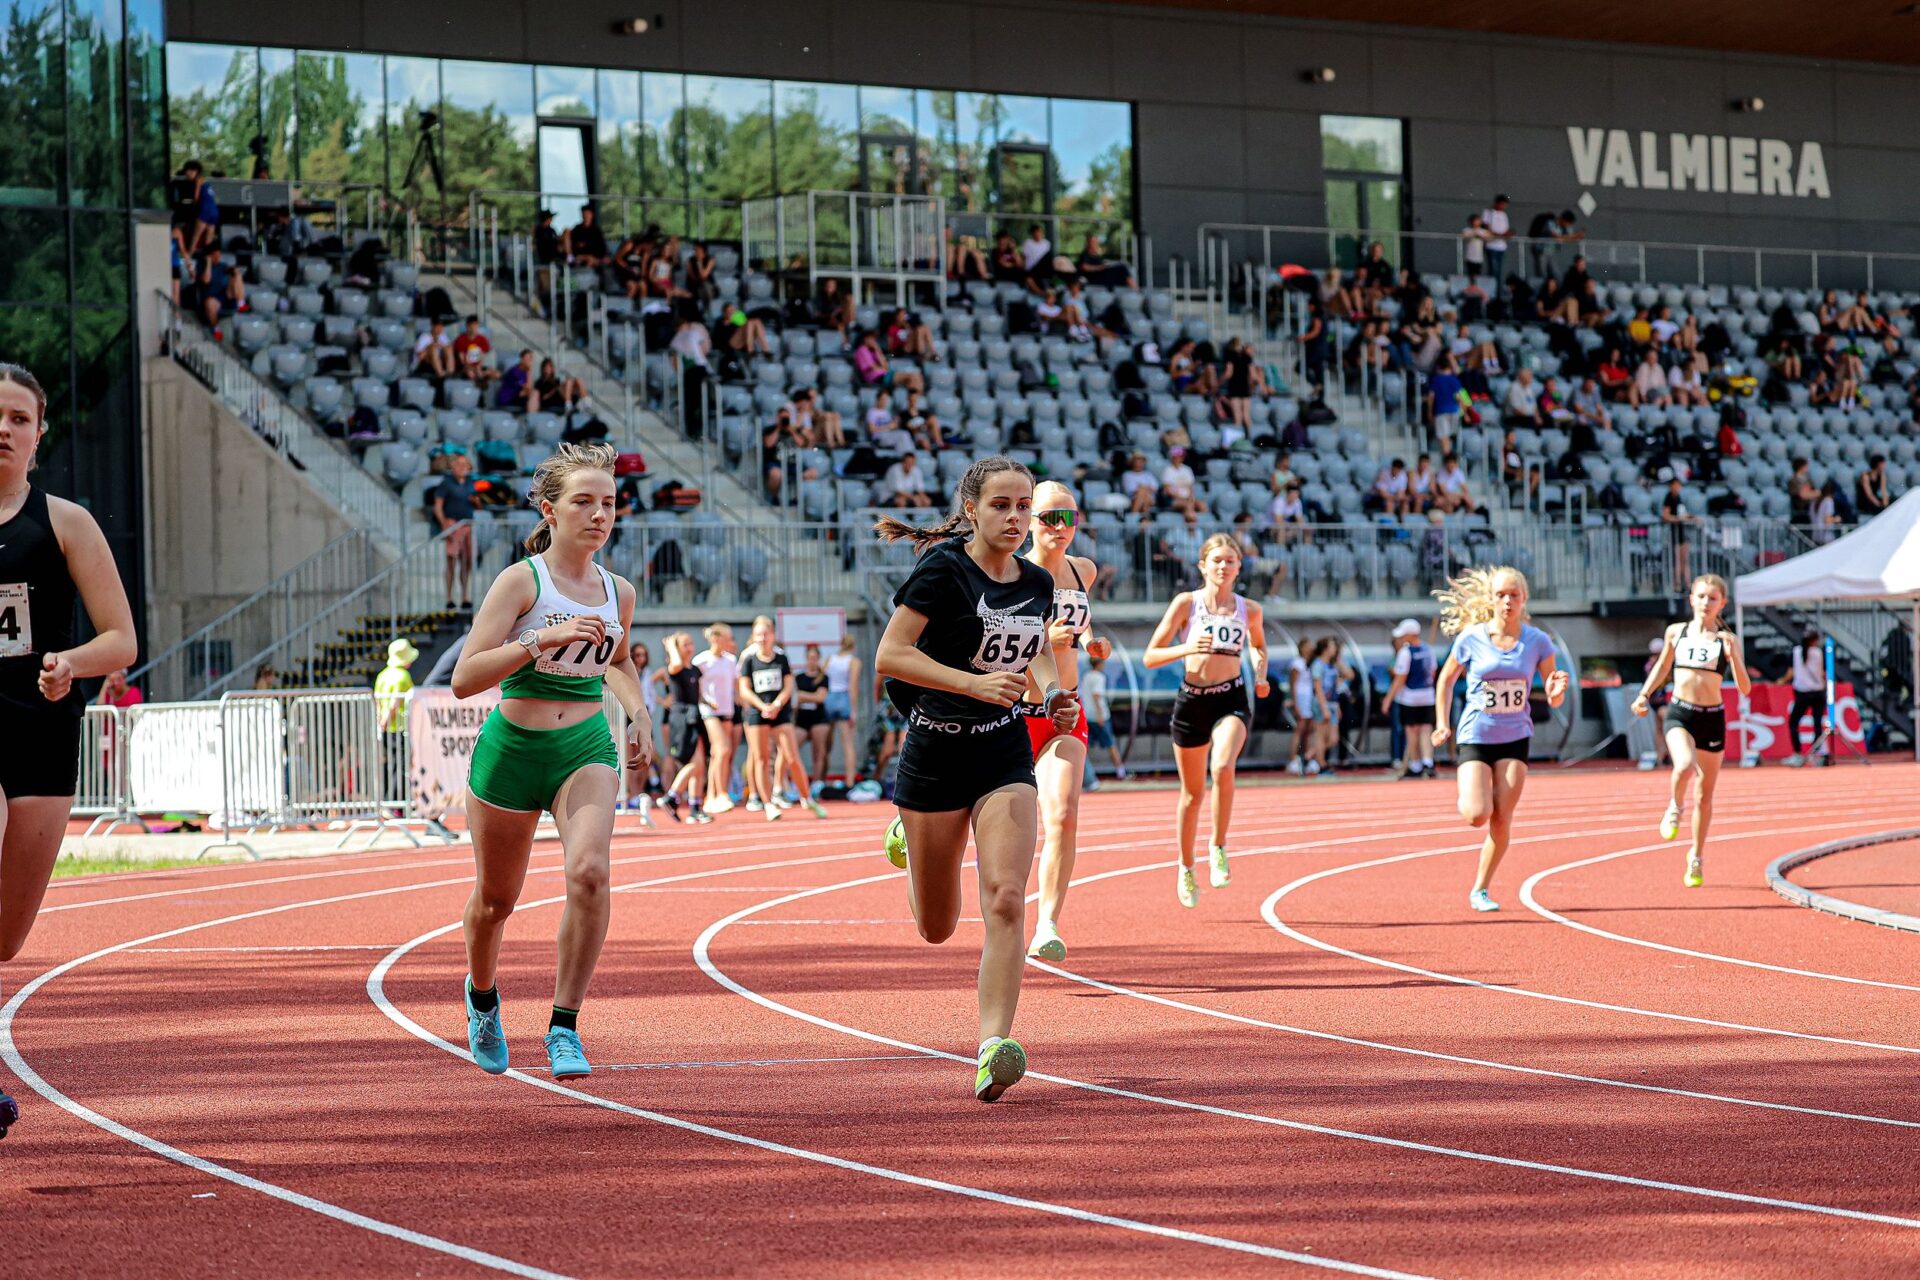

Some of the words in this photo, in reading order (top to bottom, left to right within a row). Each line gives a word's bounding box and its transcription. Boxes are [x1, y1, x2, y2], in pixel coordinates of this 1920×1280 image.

[1567, 126, 1831, 199] VALMIERA
[1053, 603, 1088, 626] 127
[982, 633, 1040, 664] 654
[1688, 648, 1708, 662] 13
[1486, 690, 1523, 708] 318
[916, 715, 962, 734] PRO
[971, 714, 1011, 734] NIKE
